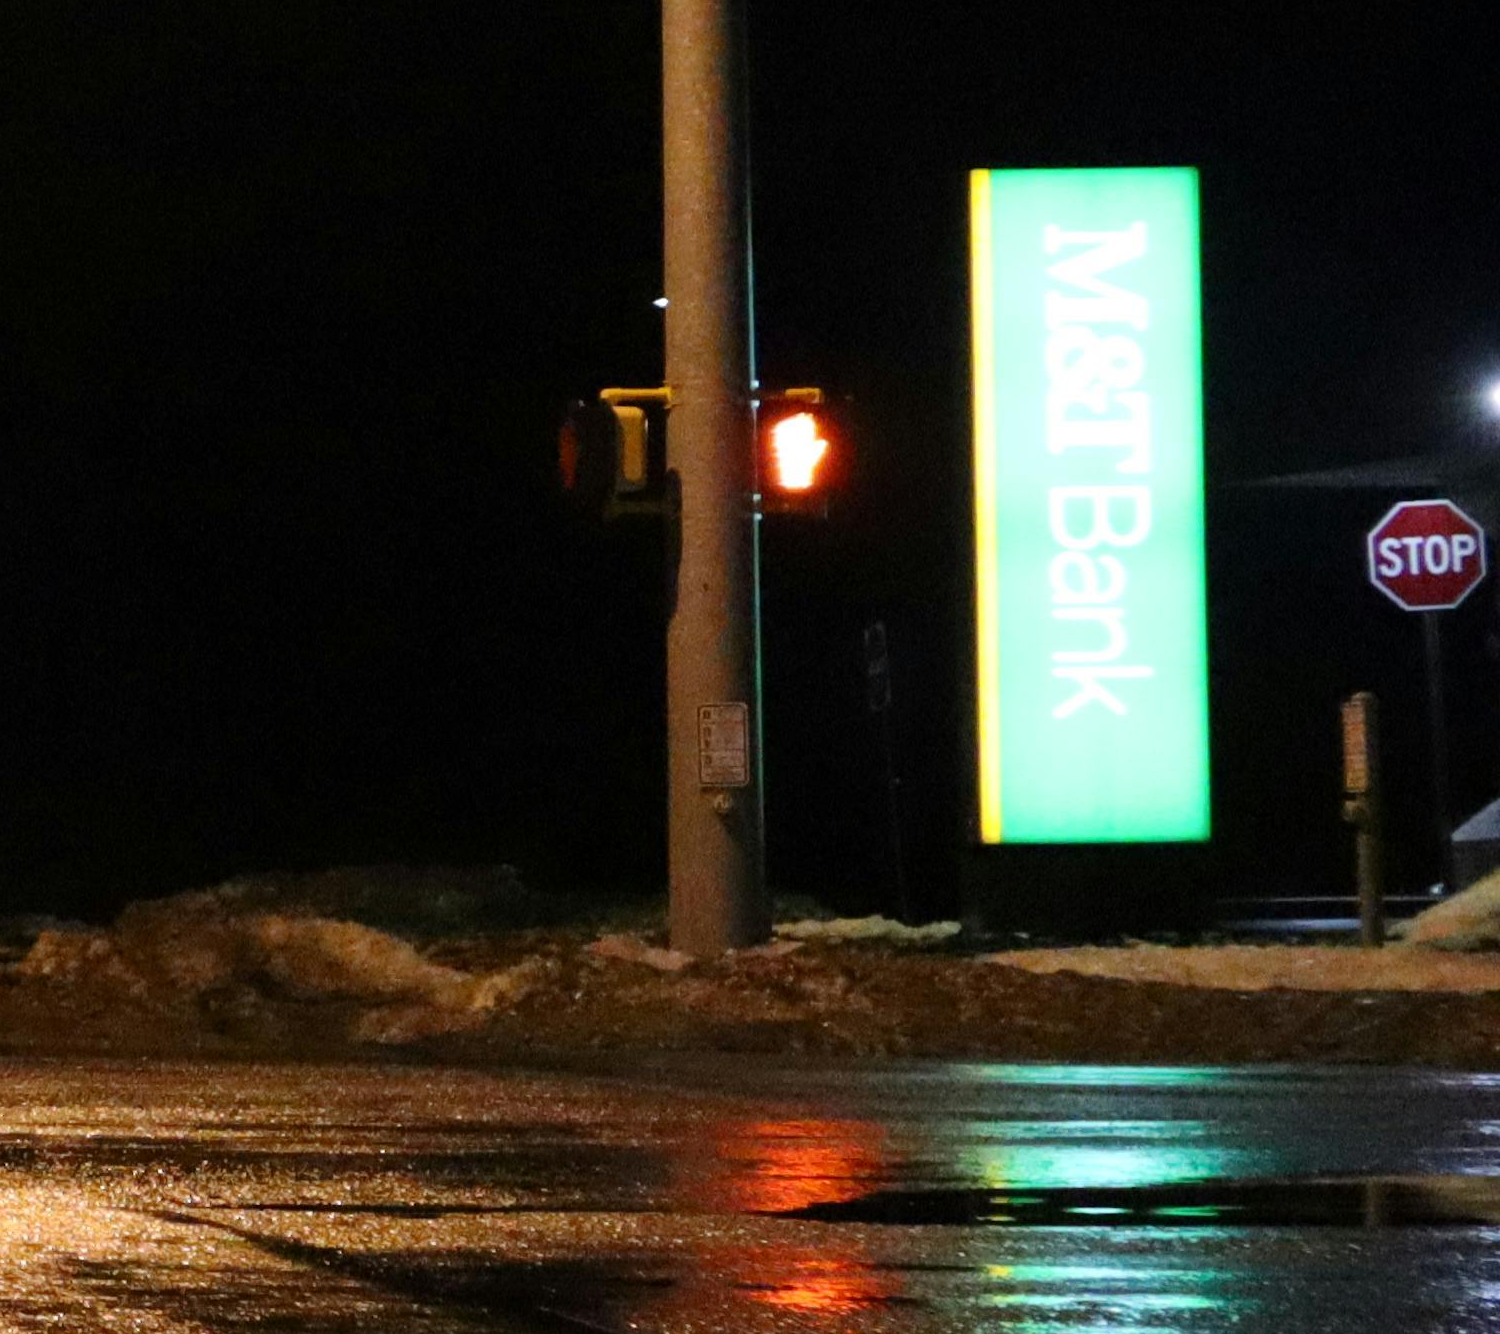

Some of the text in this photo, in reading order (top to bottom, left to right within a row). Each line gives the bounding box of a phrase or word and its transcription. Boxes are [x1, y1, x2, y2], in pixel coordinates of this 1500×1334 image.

[1043, 220, 1154, 719] M&T Bank
[1378, 534, 1477, 578] STOP
